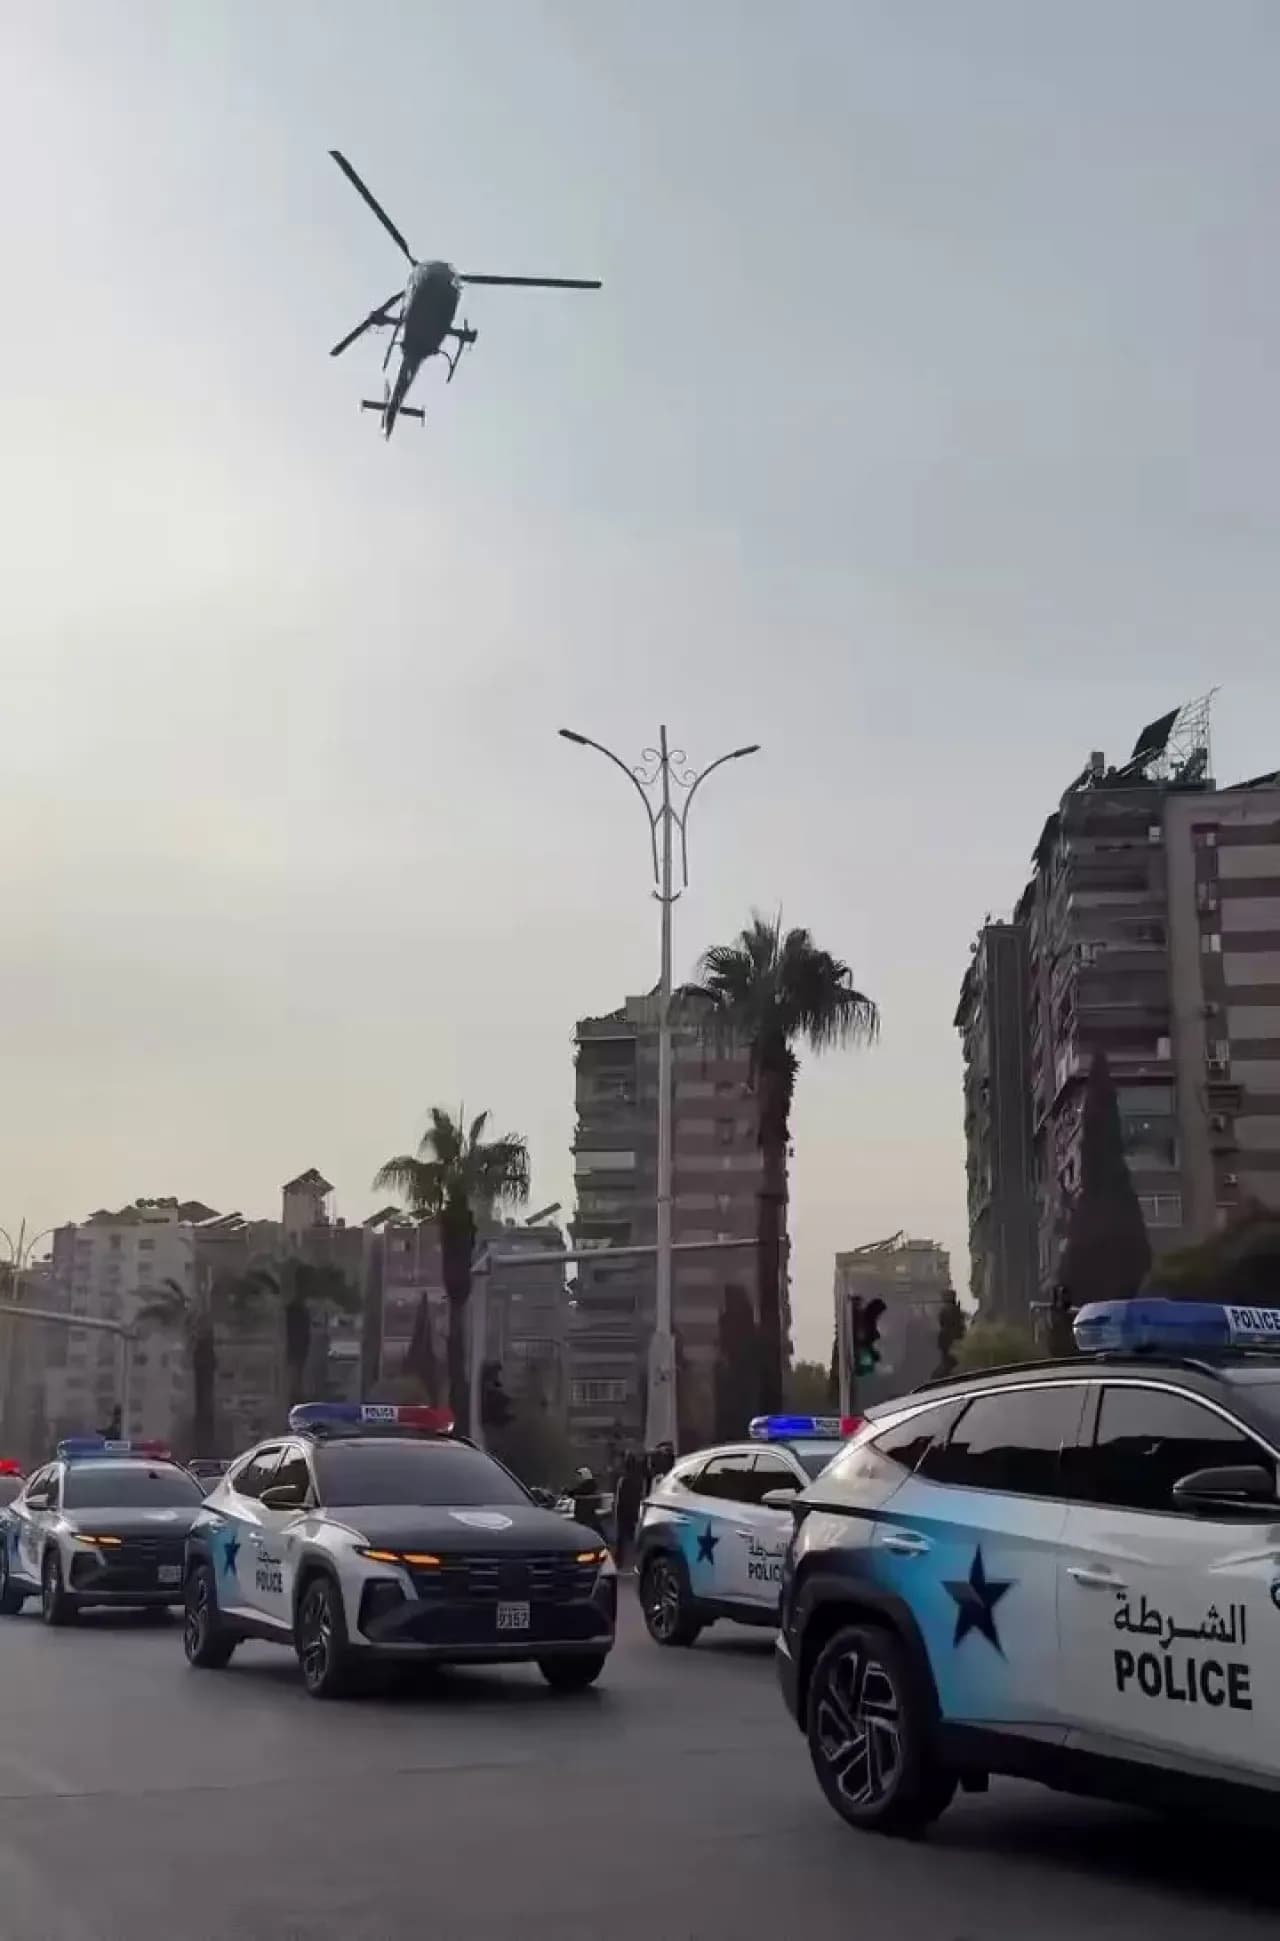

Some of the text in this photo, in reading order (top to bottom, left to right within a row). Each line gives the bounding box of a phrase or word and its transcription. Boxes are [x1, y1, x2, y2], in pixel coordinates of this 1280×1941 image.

[1231, 1309, 1280, 1330] POLICE
[255, 1570, 283, 1593] POLICE
[748, 1562, 785, 1582] POLIC
[1114, 1592, 1246, 1650] الشرطة
[1114, 1649, 1253, 1711] POLICE
